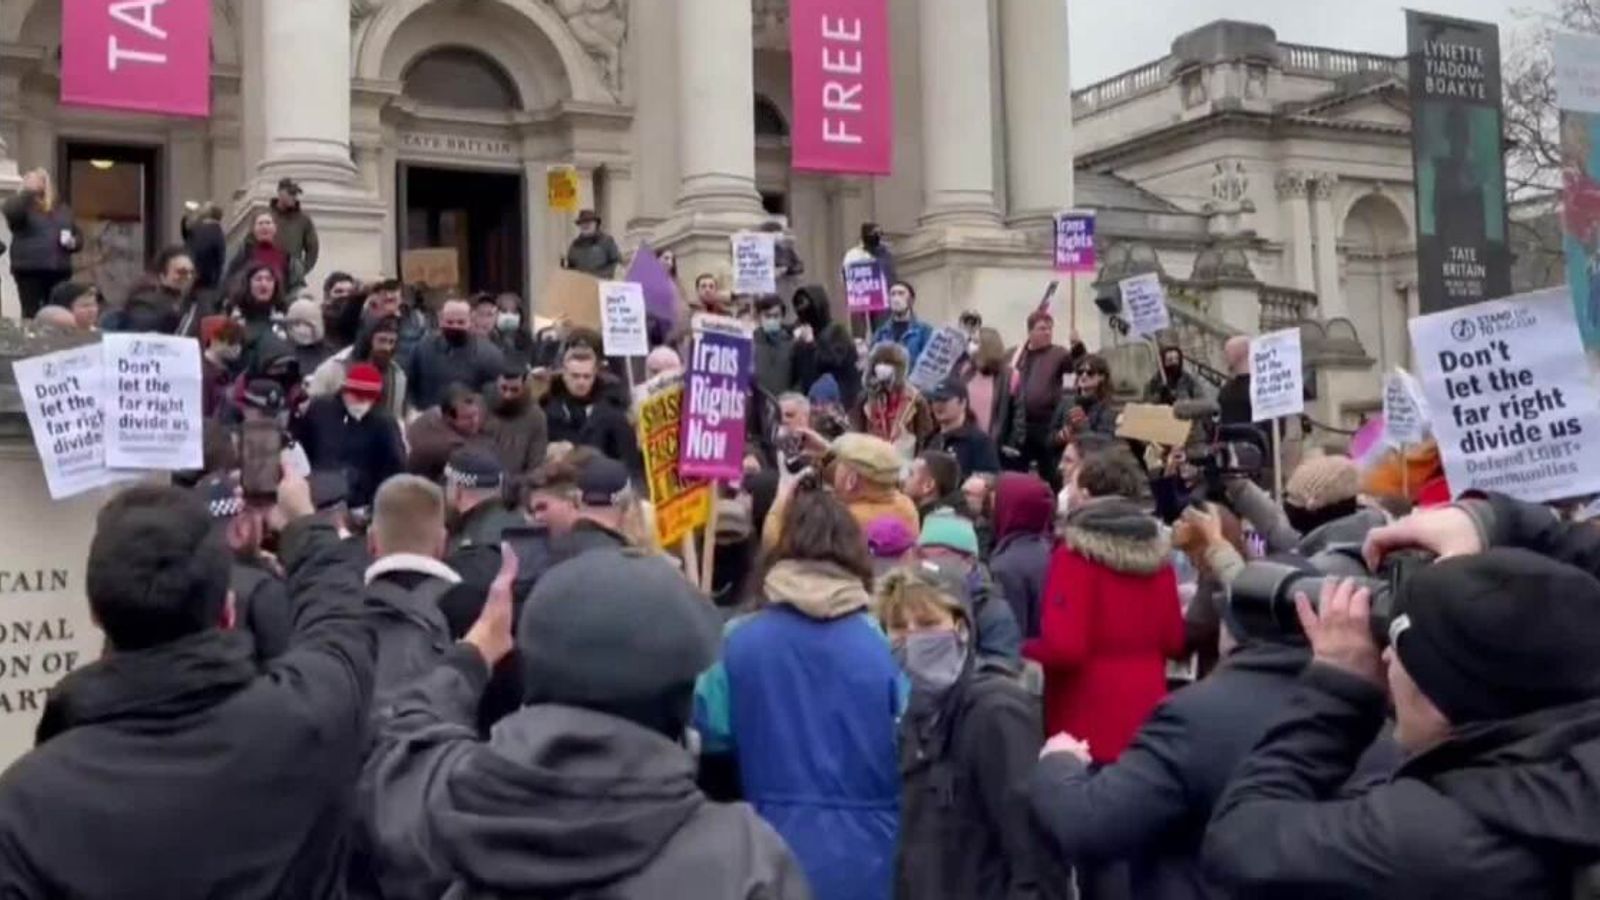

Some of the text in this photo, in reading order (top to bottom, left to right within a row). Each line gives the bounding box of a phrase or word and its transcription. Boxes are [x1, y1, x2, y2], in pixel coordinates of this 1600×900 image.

[1424, 40, 1484, 64] LYNETTE
[822, 14, 863, 144] FREE
[1425, 76, 1486, 98] BOAKYE
[403, 134, 512, 154] TATE BRITAIN
[1450, 246, 1477, 261] TATE
[1442, 263, 1486, 278] BRITAIN
[118, 357, 161, 374] Don't
[692, 333, 739, 377] Trans
[1438, 340, 1511, 373] Don't
[35, 376, 80, 399] Don't
[118, 377, 171, 393] let the
[1445, 368, 1534, 400] let the
[40, 395, 96, 417] let the
[118, 395, 184, 415] far right
[690, 374, 745, 425] Rights
[1452, 387, 1566, 428] far right
[46, 419, 71, 436] far
[119, 414, 190, 431] divide us
[53, 431, 103, 455] divide
[686, 418, 728, 460] Now
[1460, 417, 1582, 454] divide us
[1466, 441, 1581, 474] Defend LGBT+
[1471, 462, 1579, 489] communities
[42, 651, 78, 674] OF
